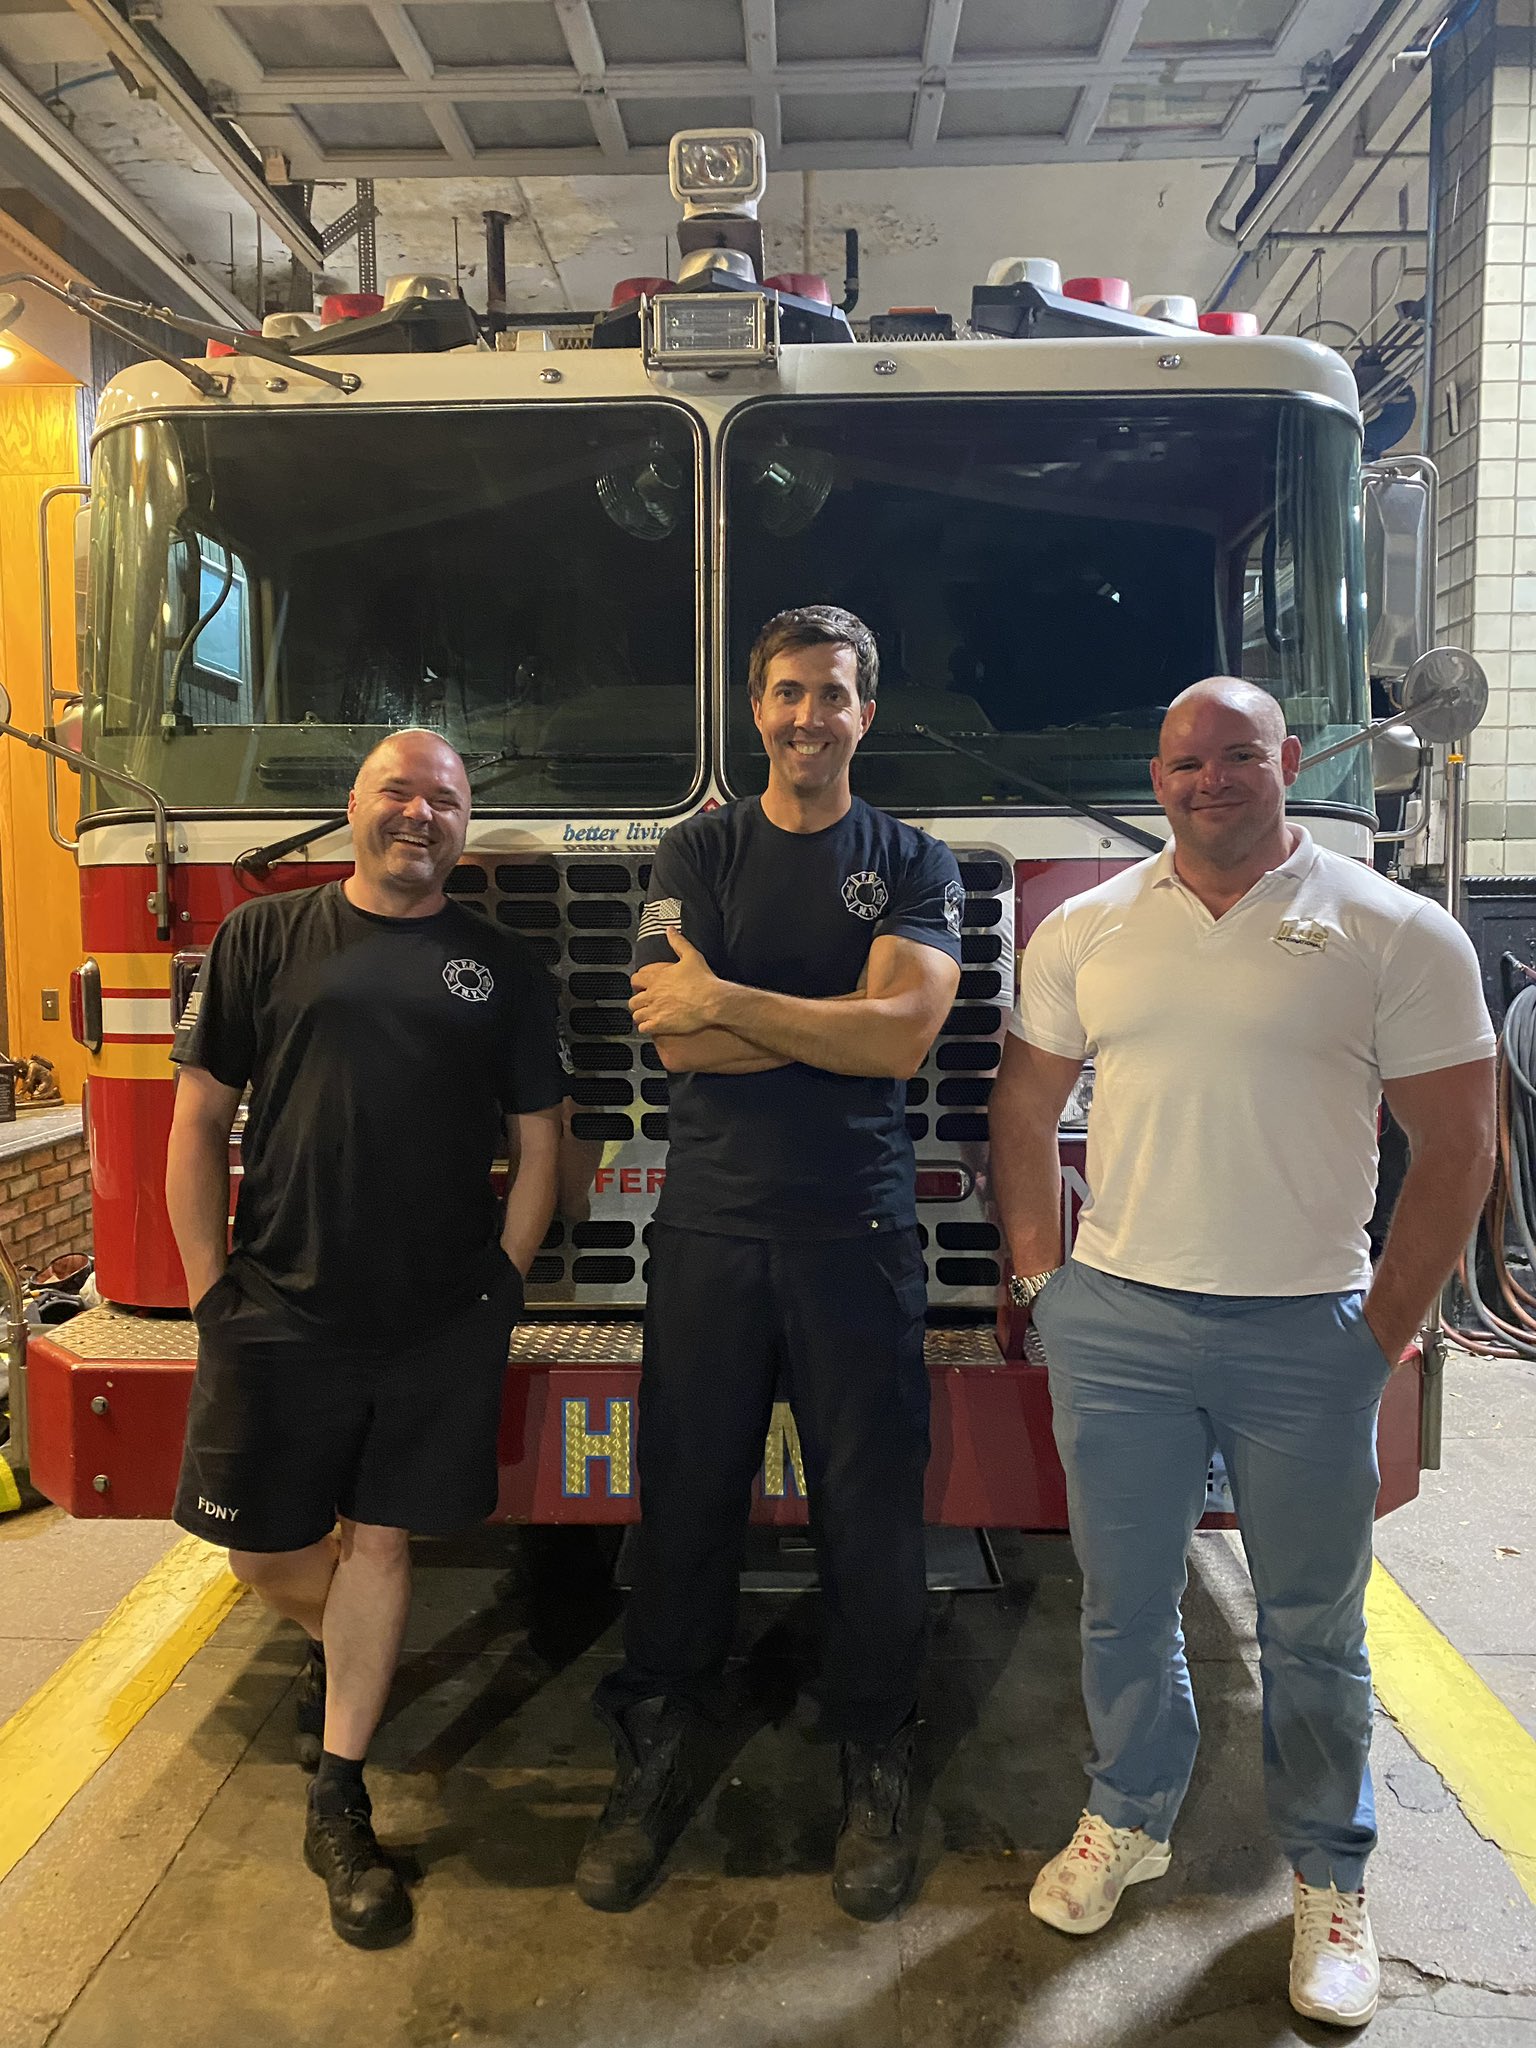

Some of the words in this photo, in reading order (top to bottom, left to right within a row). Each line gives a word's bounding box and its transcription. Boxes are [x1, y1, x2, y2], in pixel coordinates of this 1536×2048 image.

[563, 823, 620, 841] better
[626, 822, 670, 840] livin
[595, 1168, 667, 1194] FER
[197, 1495, 240, 1522] FDNY
